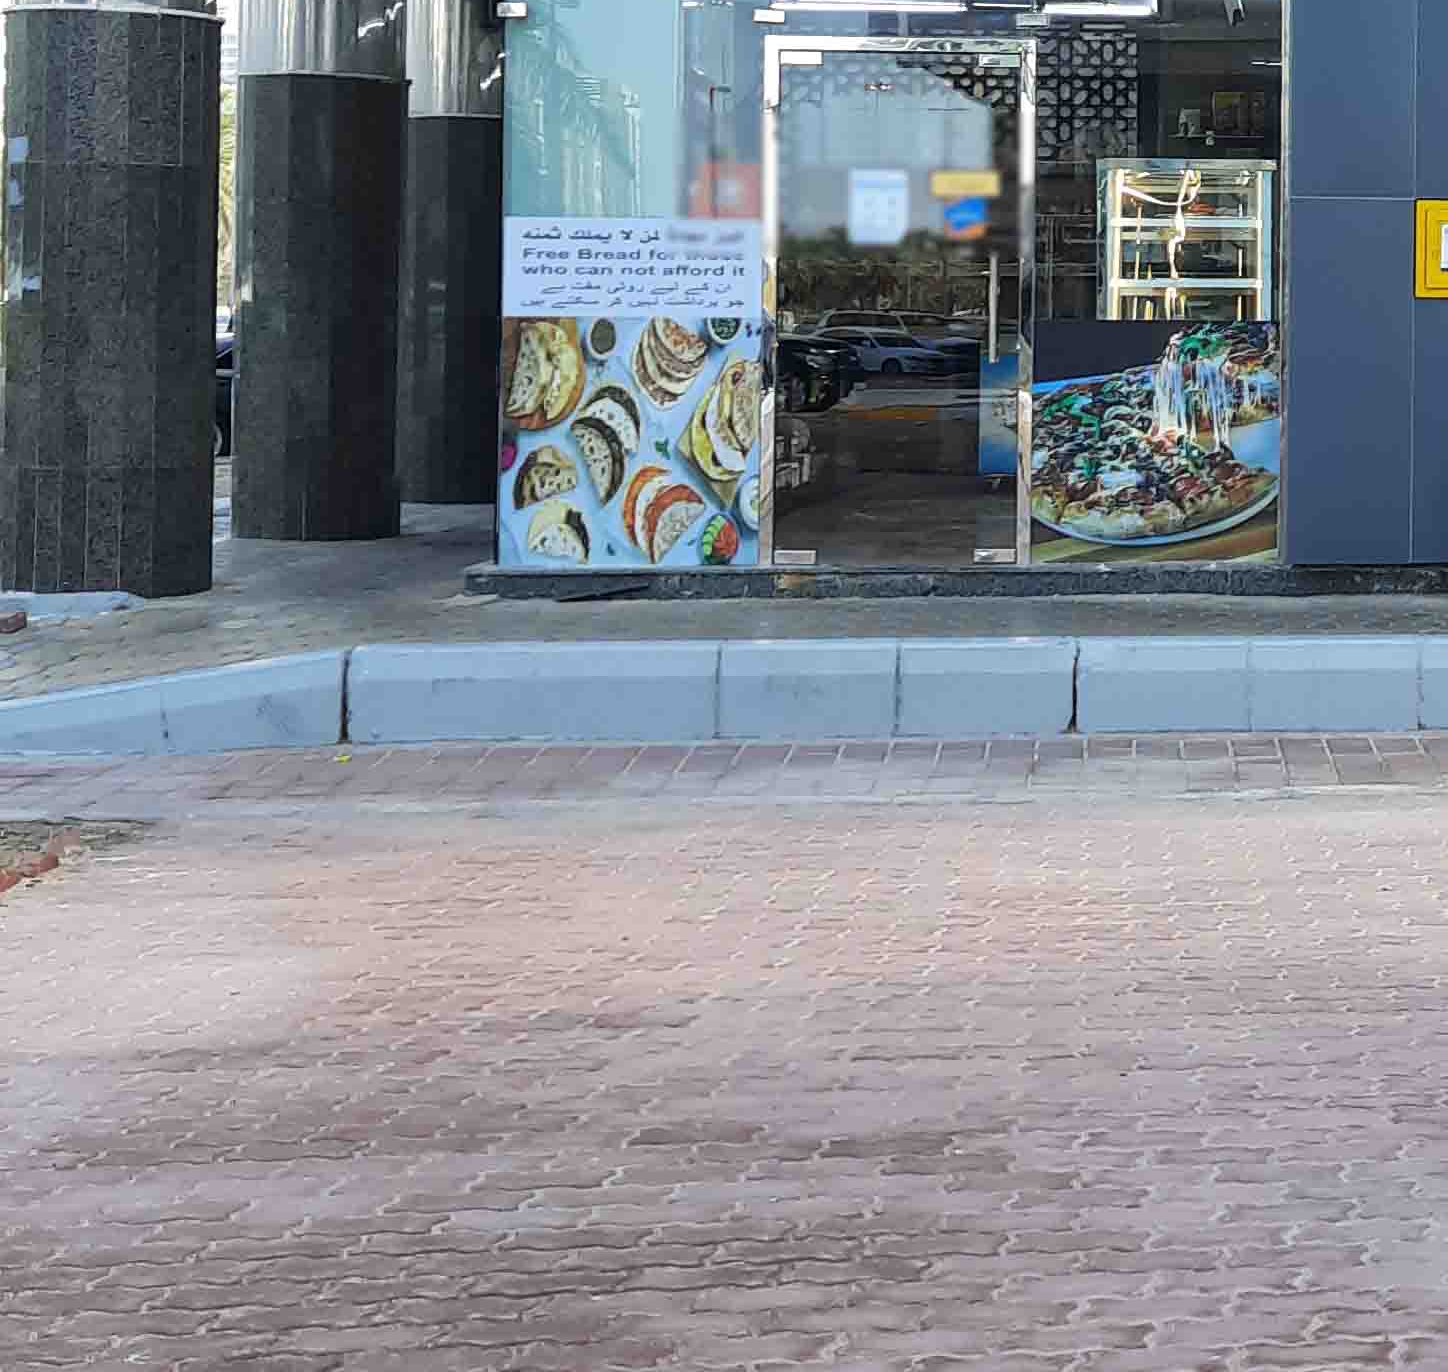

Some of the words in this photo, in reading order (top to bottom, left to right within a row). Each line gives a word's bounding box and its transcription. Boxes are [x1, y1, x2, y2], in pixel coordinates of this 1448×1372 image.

[523, 248, 569, 260] Free
[577, 248, 641, 260] Bread
[522, 264, 568, 275] who
[575, 267, 613, 275] can
[621, 266, 656, 276] not
[663, 265, 725, 276] afford
[732, 265, 745, 276] it
